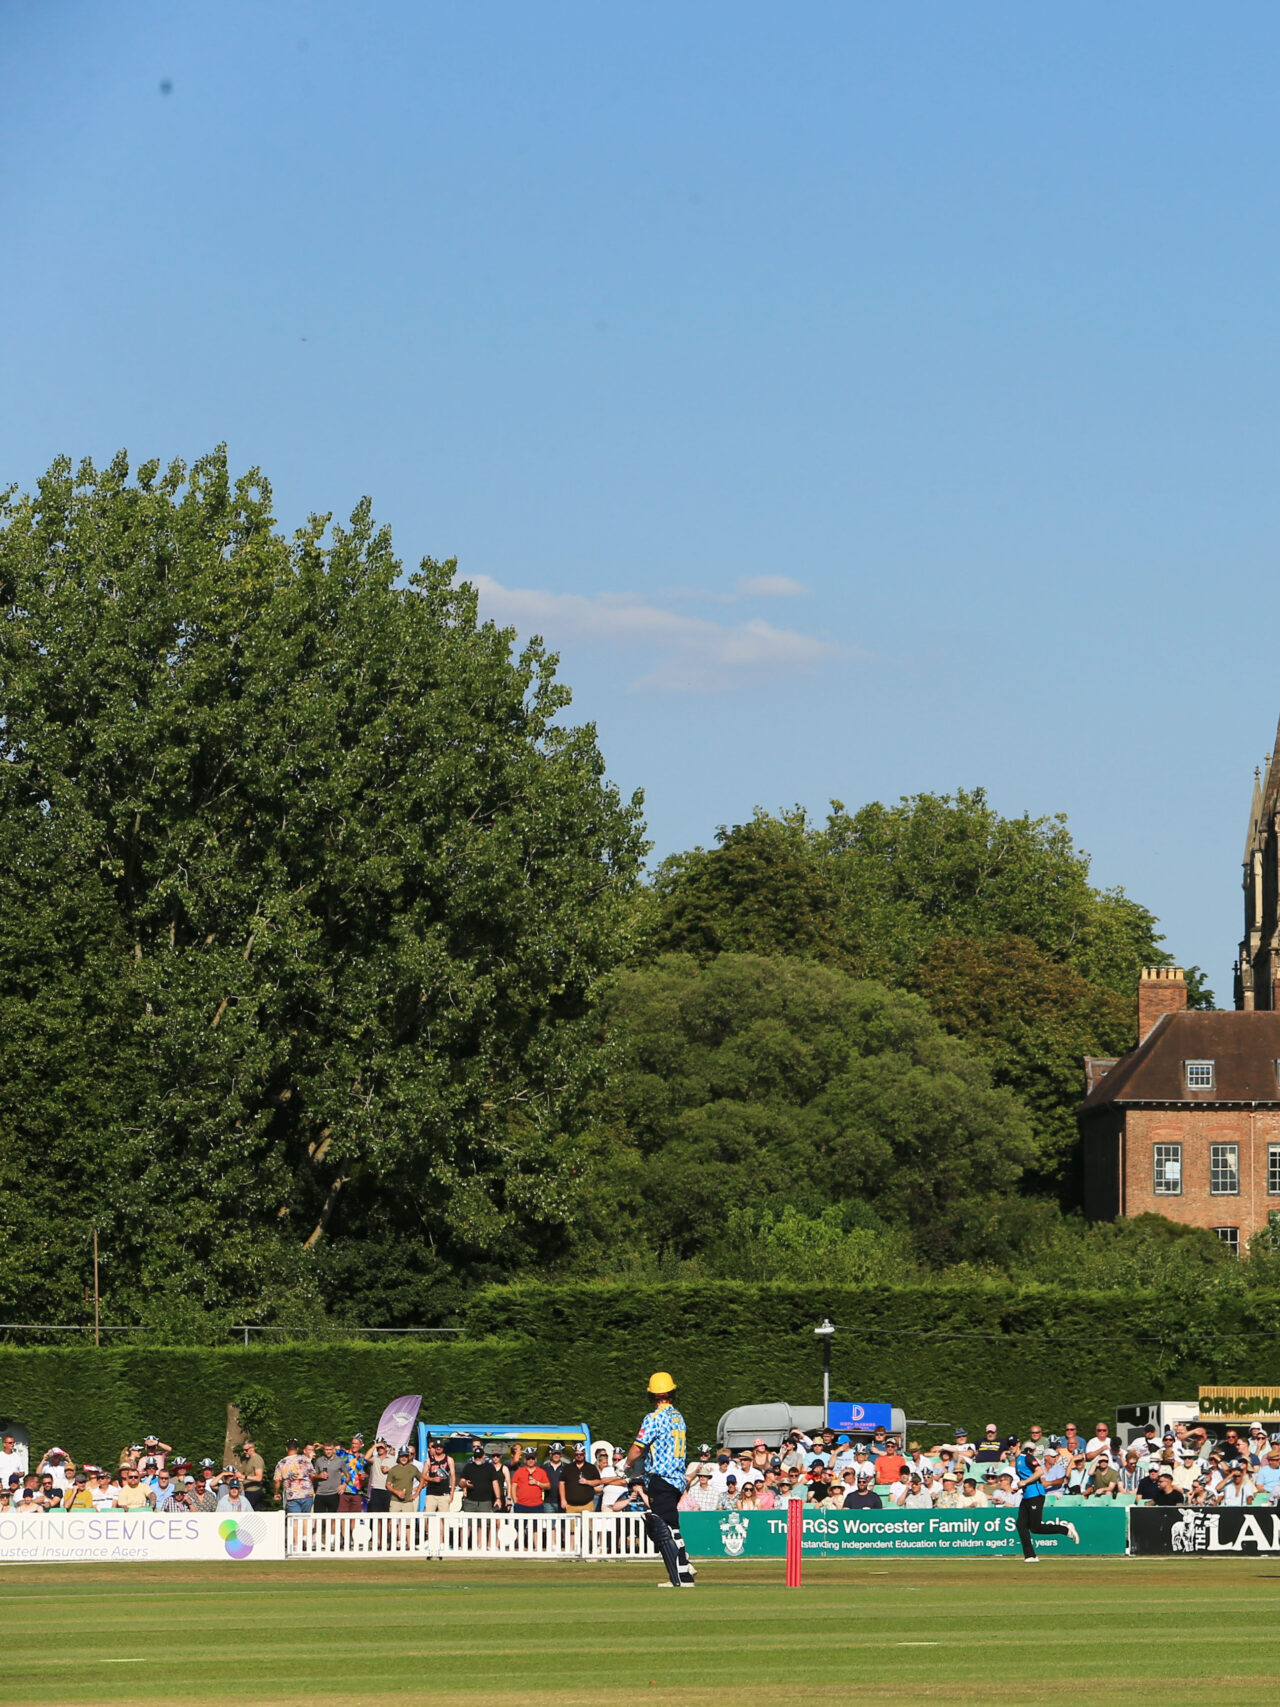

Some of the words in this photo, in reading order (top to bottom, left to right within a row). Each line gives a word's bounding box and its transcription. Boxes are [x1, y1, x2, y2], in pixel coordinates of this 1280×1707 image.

[767, 1519, 788, 1534] Th
[802, 1518, 839, 1535] RGS
[844, 1519, 924, 1535] Worcester
[929, 1518, 979, 1536] Family
[984, 1517, 1001, 1532] of
[841, 1540, 893, 1551] Independent
[895, 1540, 938, 1549] Education
[938, 1539, 950, 1548] for
[952, 1539, 984, 1548] children
[986, 1539, 1007, 1551] aged
[1009, 1539, 1015, 1547] 2
[1035, 1539, 1058, 1550] years
[1195, 1525, 1206, 1551] THE
[43, 1546, 110, 1558] Insurance
